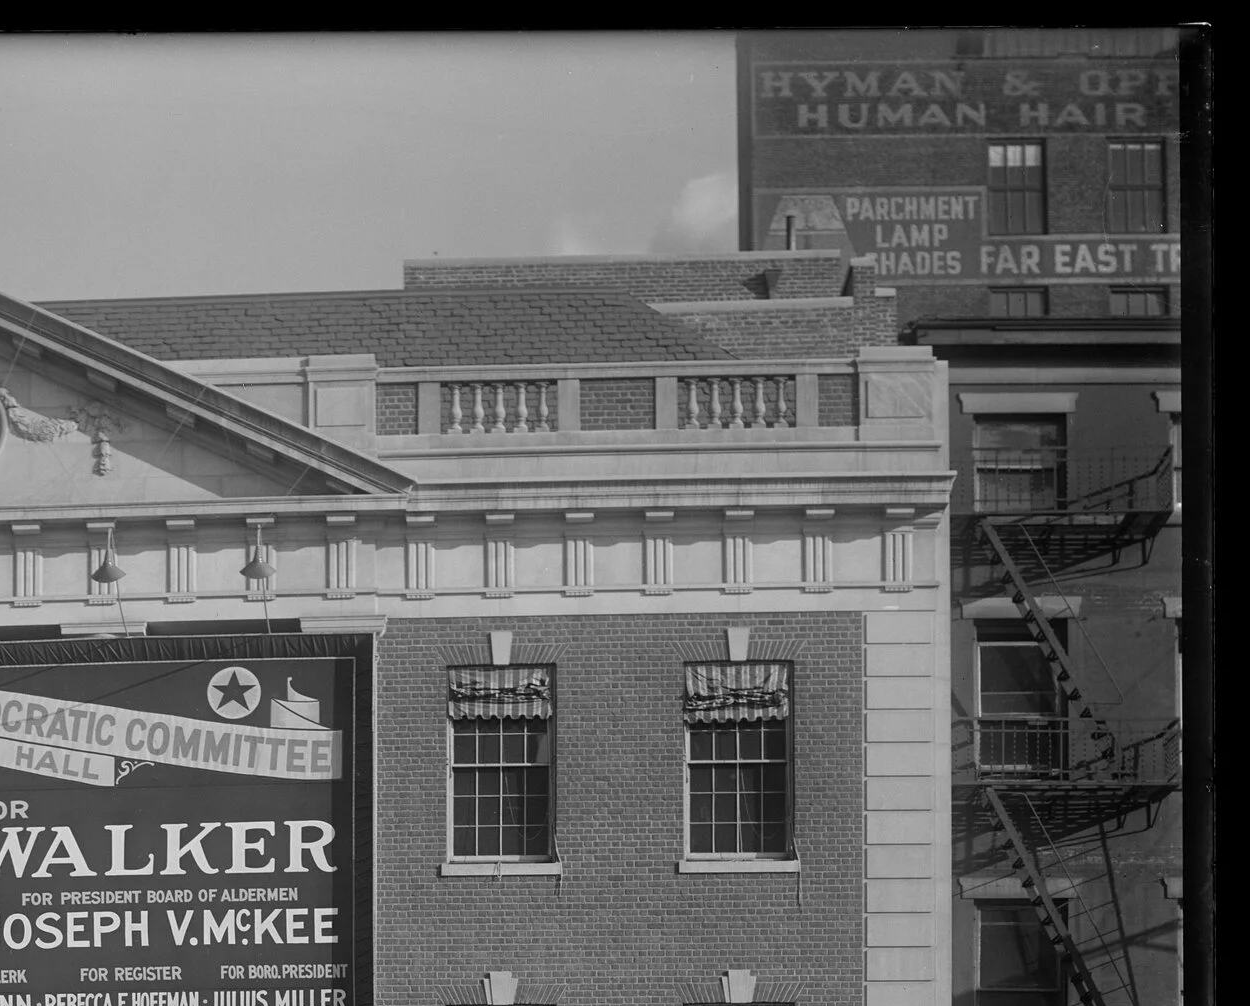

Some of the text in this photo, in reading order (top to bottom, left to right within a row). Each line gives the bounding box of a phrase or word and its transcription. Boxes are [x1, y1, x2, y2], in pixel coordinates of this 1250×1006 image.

[760, 70, 965, 98] HYMAN
[1002, 71, 1041, 97] &
[797, 102, 1147, 128] HUMAN HAIR
[846, 196, 979, 220] PARCHMENT
[876, 223, 949, 248] LAMP
[980, 245, 1042, 275] FAR
[1054, 243, 1137, 274] EAST
[125, 718, 331, 773] COMMITTEE
[15, 745, 99, 781] HALL
[21, 887, 298, 906] FOR PRESIDENT BOARD OF ALDERMEN
[80, 965, 183, 982] FOR REGISTER
[220, 965, 245, 980] FOR
